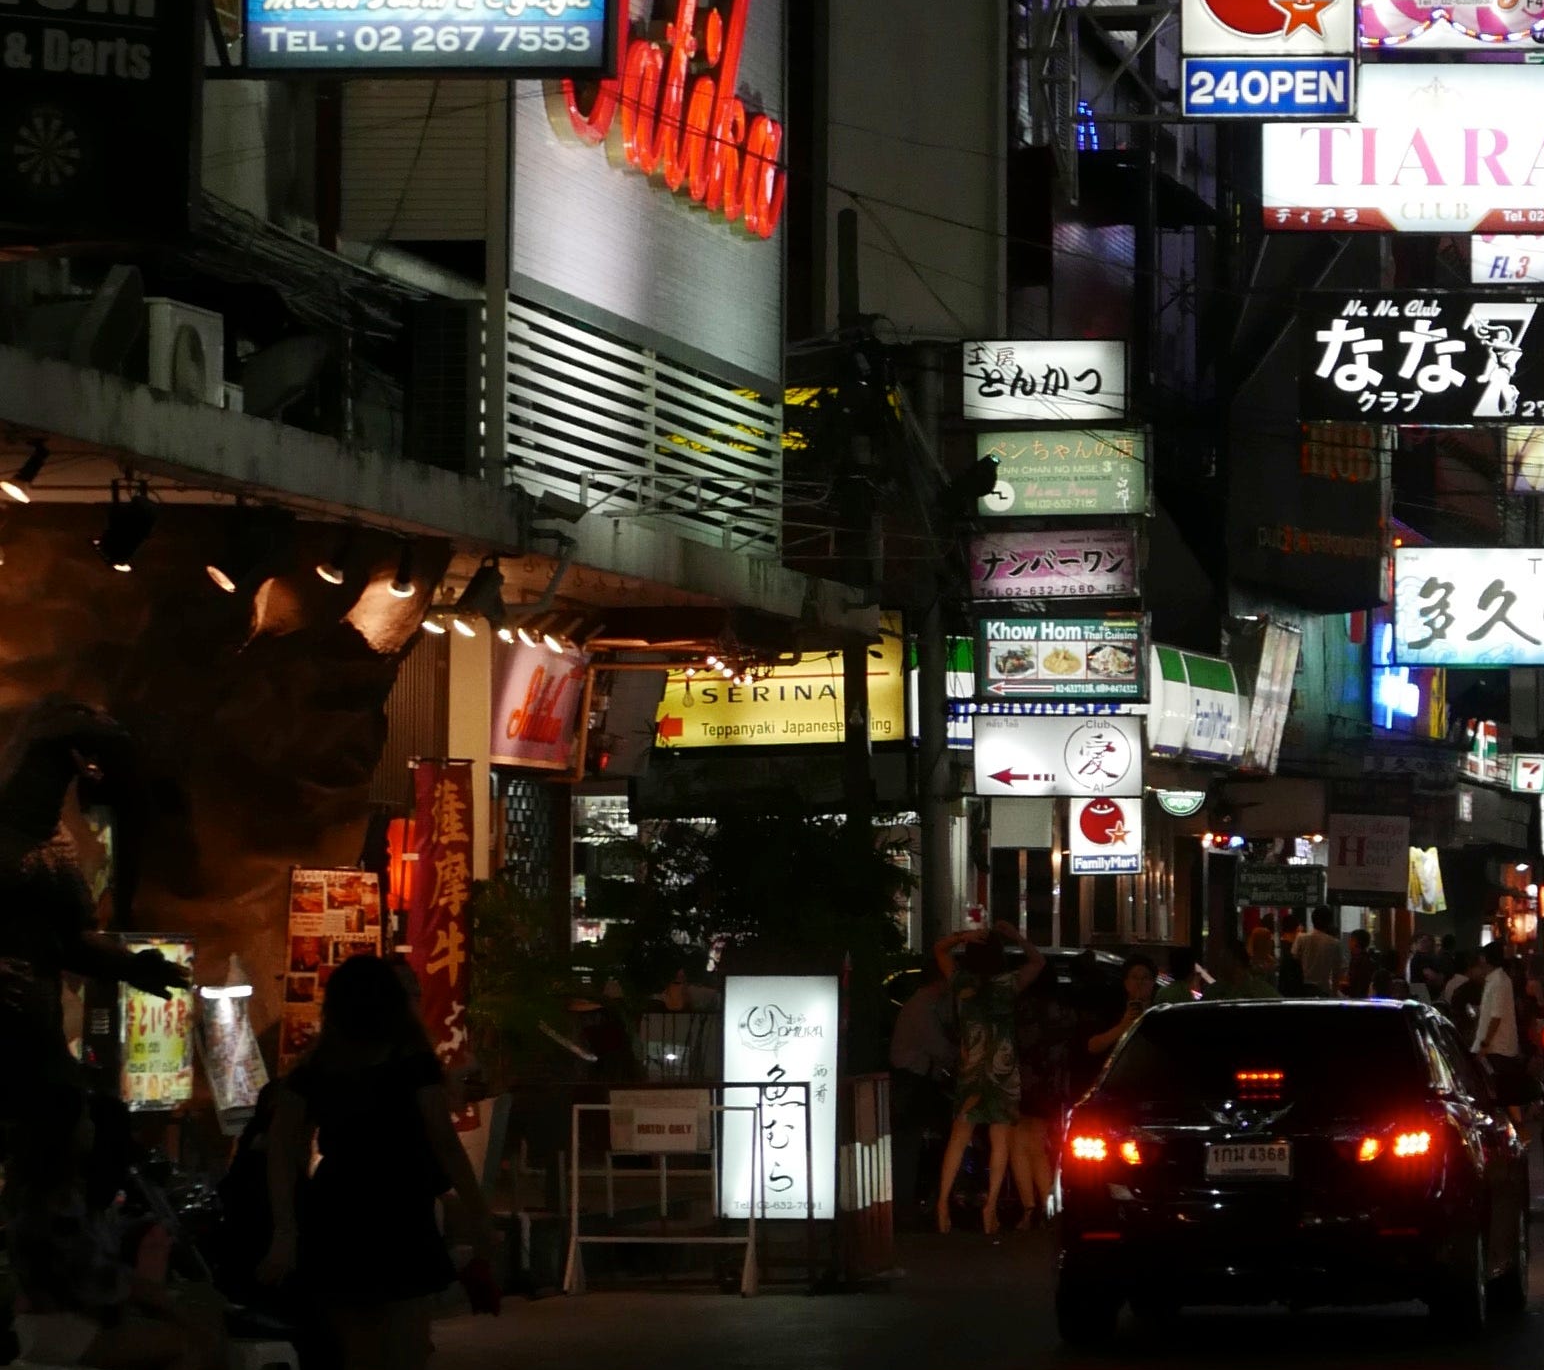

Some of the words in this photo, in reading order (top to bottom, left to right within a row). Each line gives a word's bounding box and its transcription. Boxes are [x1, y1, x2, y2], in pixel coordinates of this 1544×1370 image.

[353, 25, 404, 53] 02
[410, 25, 486, 53] 267
[492, 25, 593, 53] 7553
[40, 29, 152, 81] Darts
[1275, 207, 1359, 224] ティアラ
[1400, 201, 1471, 221] CLUB
[1503, 209, 1527, 223] Tel.
[1488, 256, 1531, 278] FL.3
[1341, 300, 1368, 317] Na
[1373, 300, 1401, 317] Na
[1404, 300, 1442, 317] Club
[1315, 319, 1467, 394] なな
[978, 364, 1102, 398] とんかつ
[1357, 390, 1424, 413] クラブ
[996, 466, 1020, 475] ENN
[1021, 466, 1051, 474] CHAN
[1054, 465, 1070, 474] NO
[1072, 464, 1099, 474] MISE
[981, 549, 1126, 582] ナンバーワン
[986, 621, 1037, 640] Khow
[1040, 621, 1082, 640] Hom
[1083, 630, 1104, 640] Thai
[1105, 630, 1139, 640] Cuisine
[701, 684, 838, 705] SERINA
[702, 721, 776, 738] Teppanyaki
[781, 719, 845, 738] Japanese
[870, 719, 892, 735] ing
[1085, 719, 1111, 730] Club
[1073, 855, 1138, 871] FamilyMart
